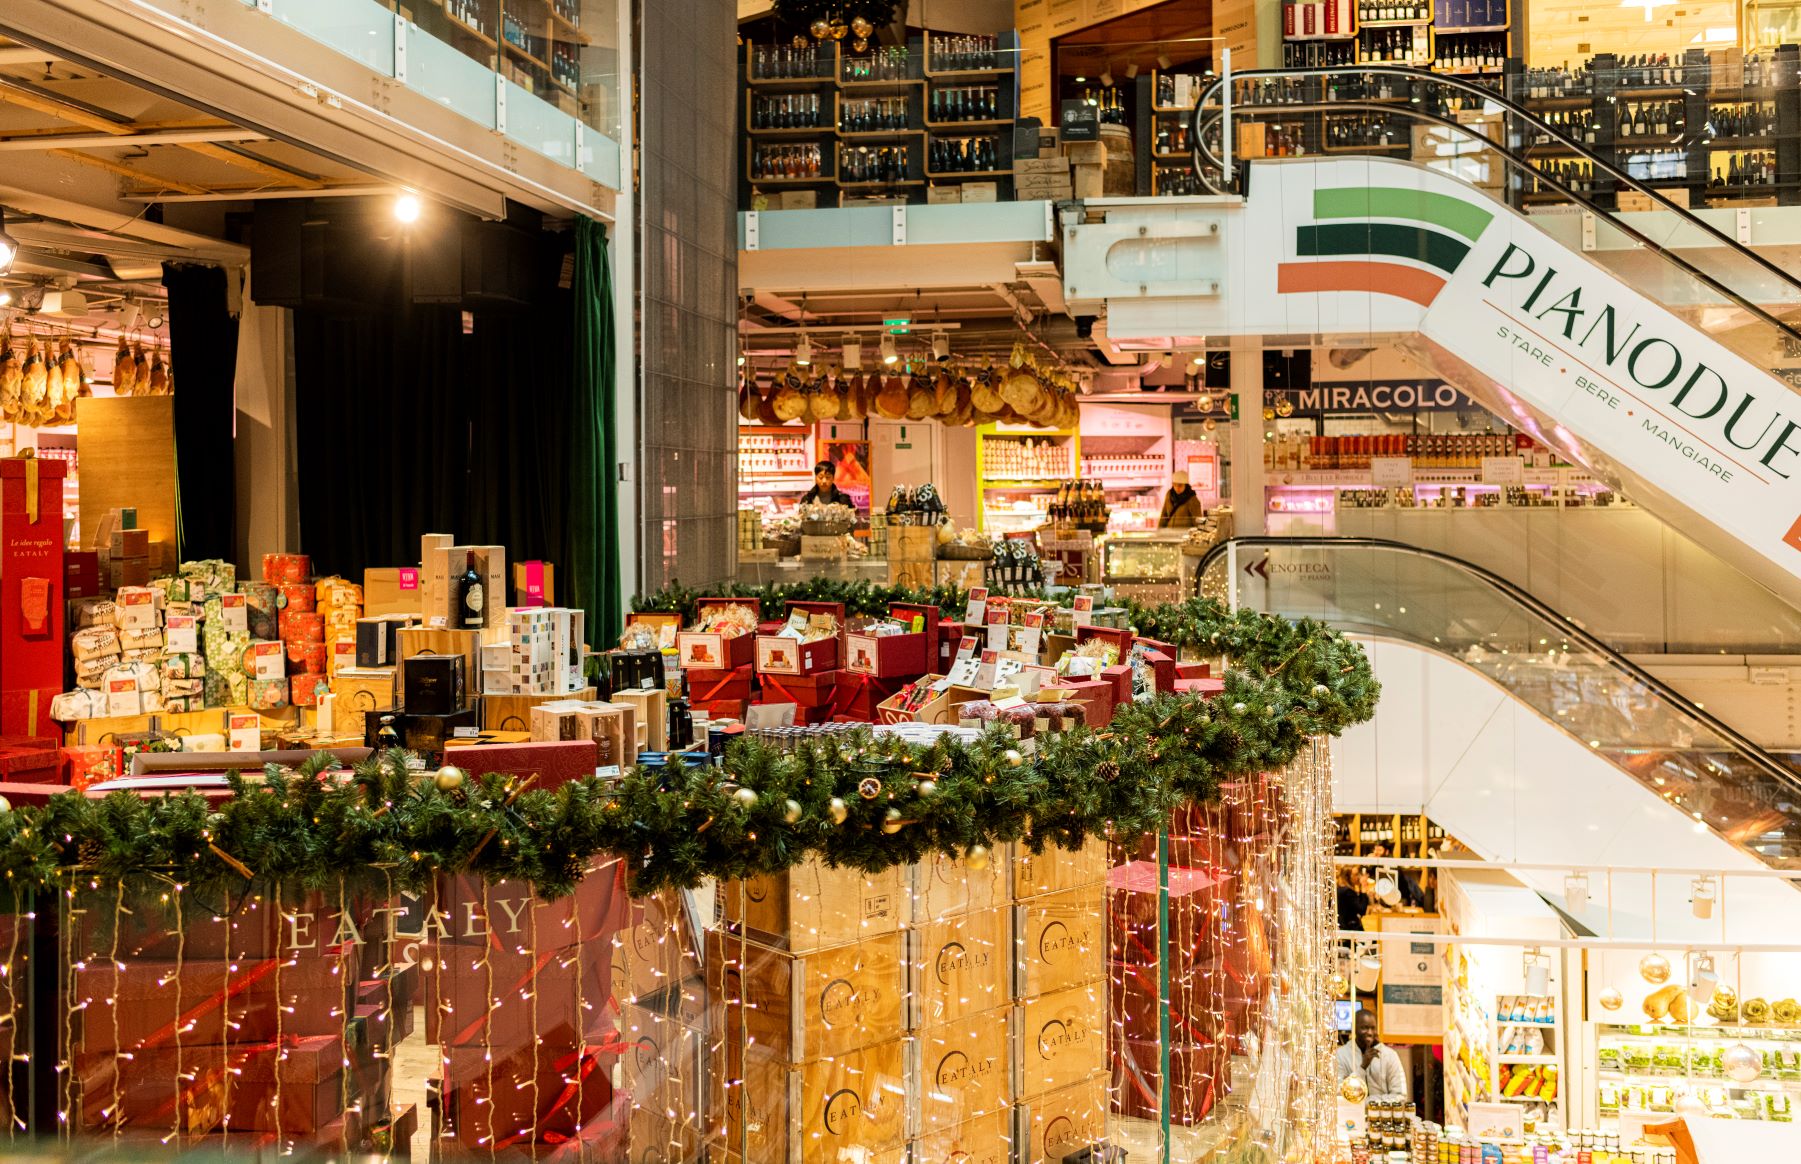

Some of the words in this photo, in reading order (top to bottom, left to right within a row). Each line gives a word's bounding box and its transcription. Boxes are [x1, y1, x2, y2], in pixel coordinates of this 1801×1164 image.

[1481, 242, 1801, 479] PIANODUE
[1300, 385, 1457, 410] MIRACOLO
[1496, 325, 1554, 367] STARE
[1574, 375, 1620, 410] BERE
[1641, 418, 1734, 484] MANGIARE
[1271, 563, 1330, 573] ENOTECA
[286, 897, 532, 949] EATALY
[942, 1059, 993, 1085] EATALY
